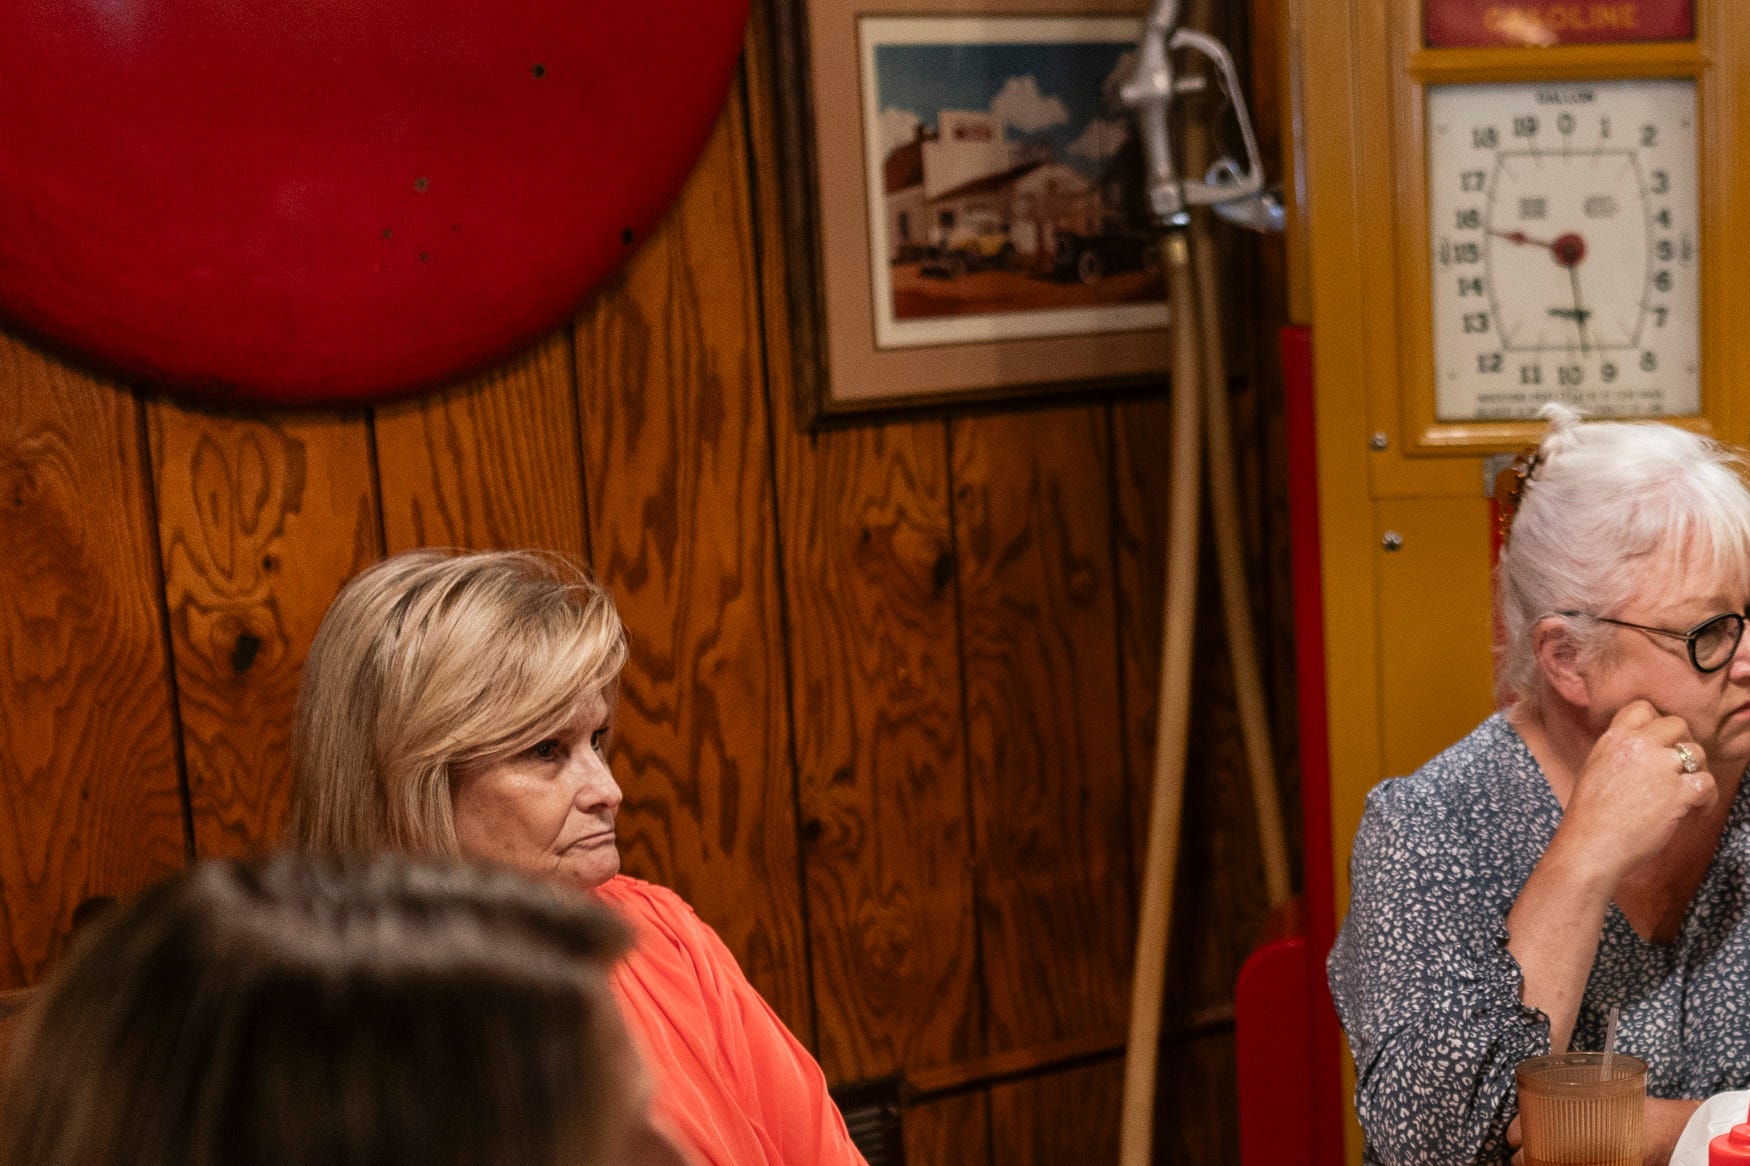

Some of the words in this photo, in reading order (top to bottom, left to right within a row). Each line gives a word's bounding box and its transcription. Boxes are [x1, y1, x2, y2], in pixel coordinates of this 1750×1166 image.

[1513, 116, 1538, 138] 19
[1557, 112, 1577, 134] 0
[1473, 127, 1498, 148] 18
[1639, 124, 1657, 147] 2
[1461, 170, 1486, 192] 17
[1652, 169, 1669, 194] 3
[1456, 208, 1481, 230] 16
[1653, 207, 1671, 229] 4
[1454, 243, 1479, 264] 15
[1656, 239, 1673, 262] 5
[1458, 276, 1483, 297] 14
[1654, 270, 1673, 293] 6
[1463, 312, 1489, 334] 13
[1651, 306, 1669, 329] 7
[1477, 352, 1503, 373] 12
[1600, 362, 1618, 383] 9
[1640, 351, 1657, 372] 8
[1520, 365, 1542, 386] 11
[1557, 366, 1584, 386] 10
